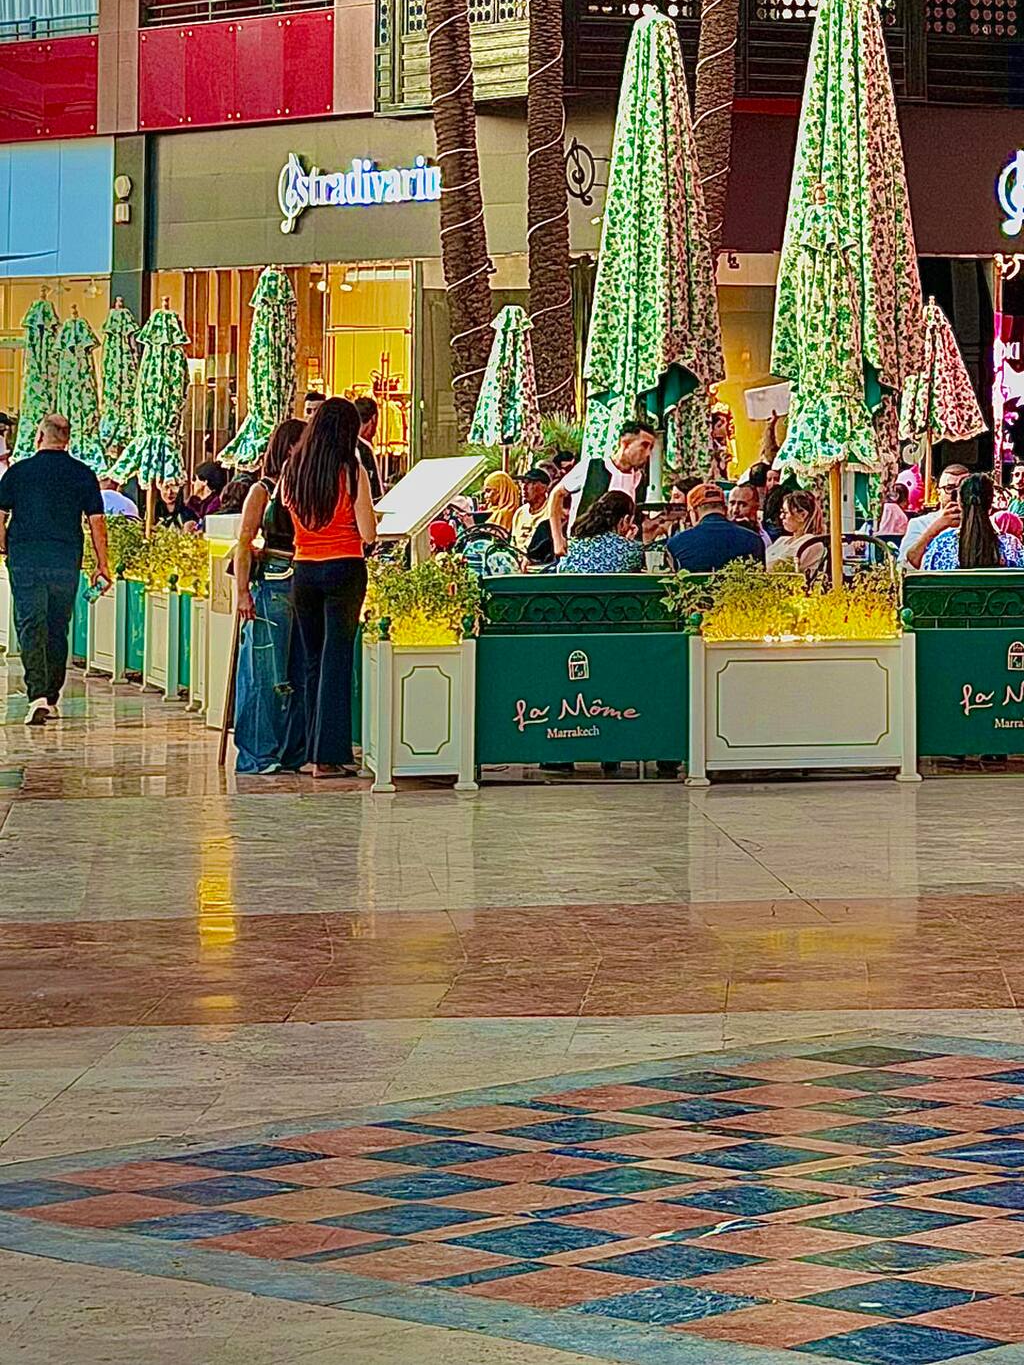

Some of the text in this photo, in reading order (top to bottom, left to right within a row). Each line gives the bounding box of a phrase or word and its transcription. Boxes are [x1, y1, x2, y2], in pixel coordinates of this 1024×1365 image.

[280, 153, 441, 216] stradivariu
[513, 692, 641, 732] La Môme
[960, 683, 995, 716] La
[547, 725, 600, 739] Marrakech
